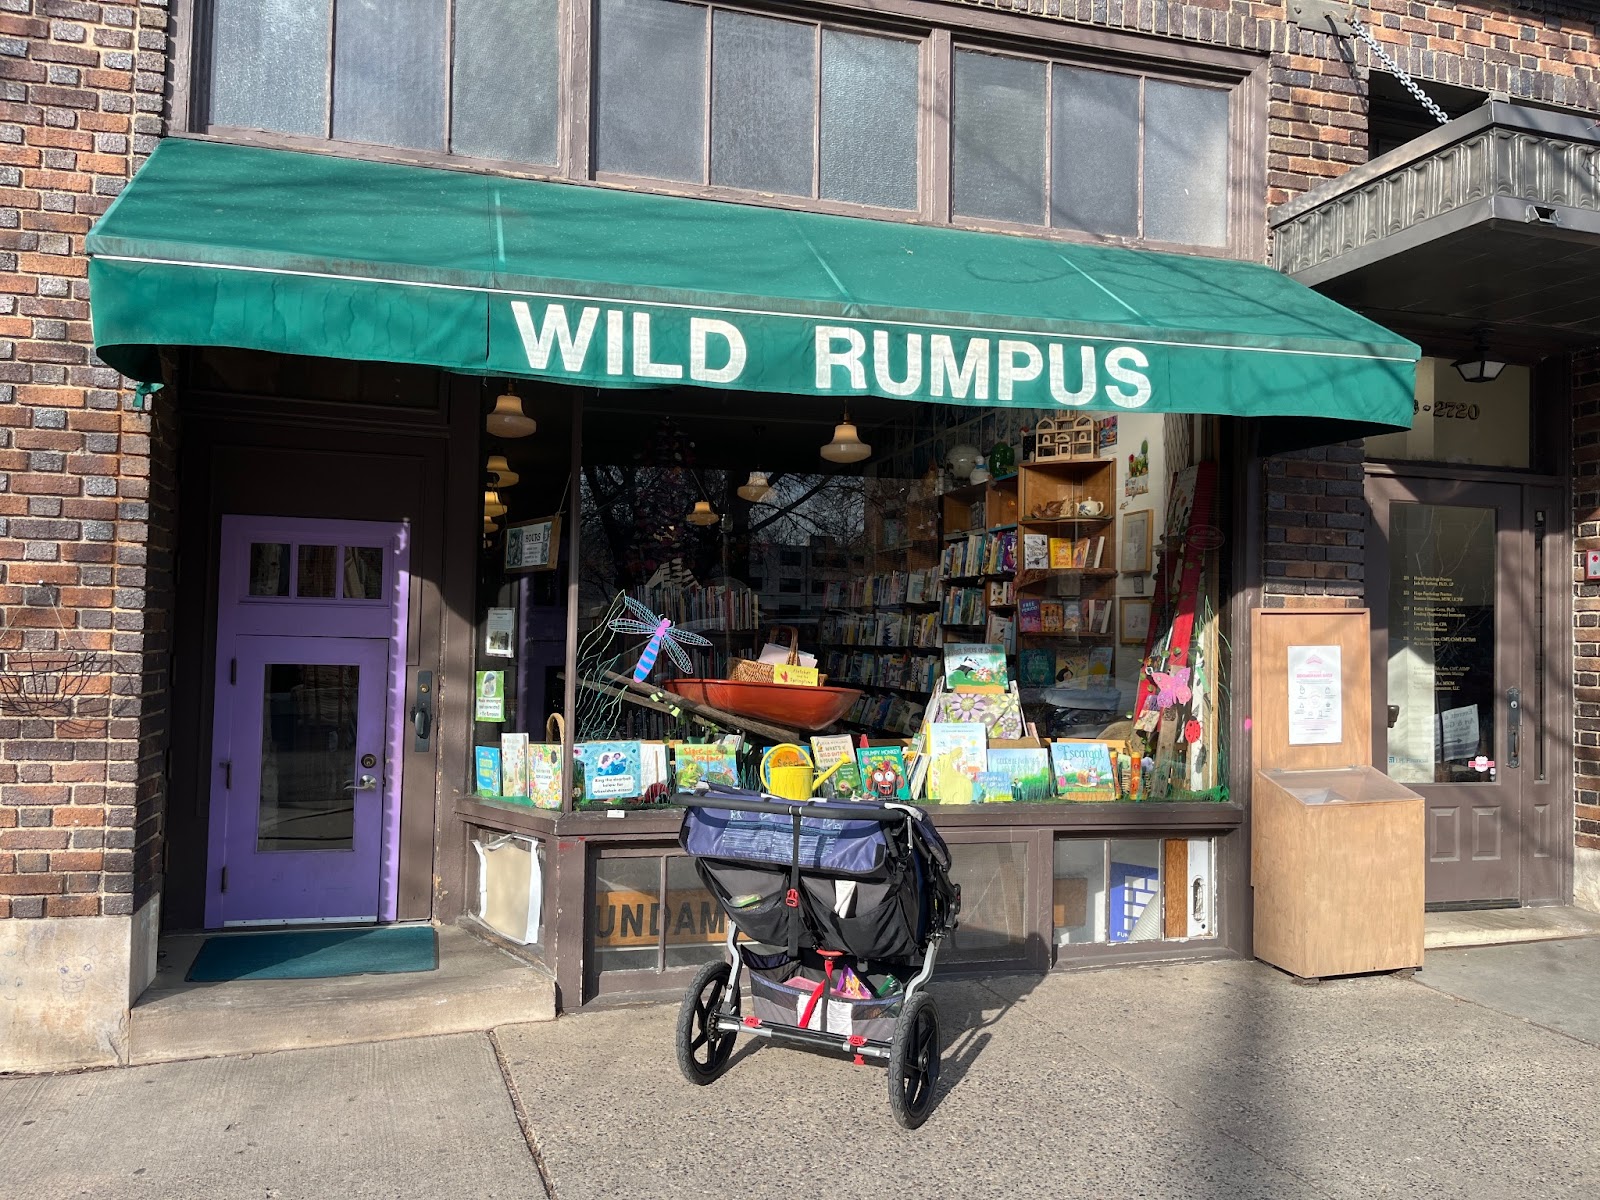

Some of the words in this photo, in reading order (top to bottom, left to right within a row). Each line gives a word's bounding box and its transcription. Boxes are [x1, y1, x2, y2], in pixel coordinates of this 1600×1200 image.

[511, 300, 747, 384] WILD
[815, 326, 1152, 409] RUMPUS
[777, 758, 799, 767] Seed
[1057, 744, 1104, 765] Escargot
